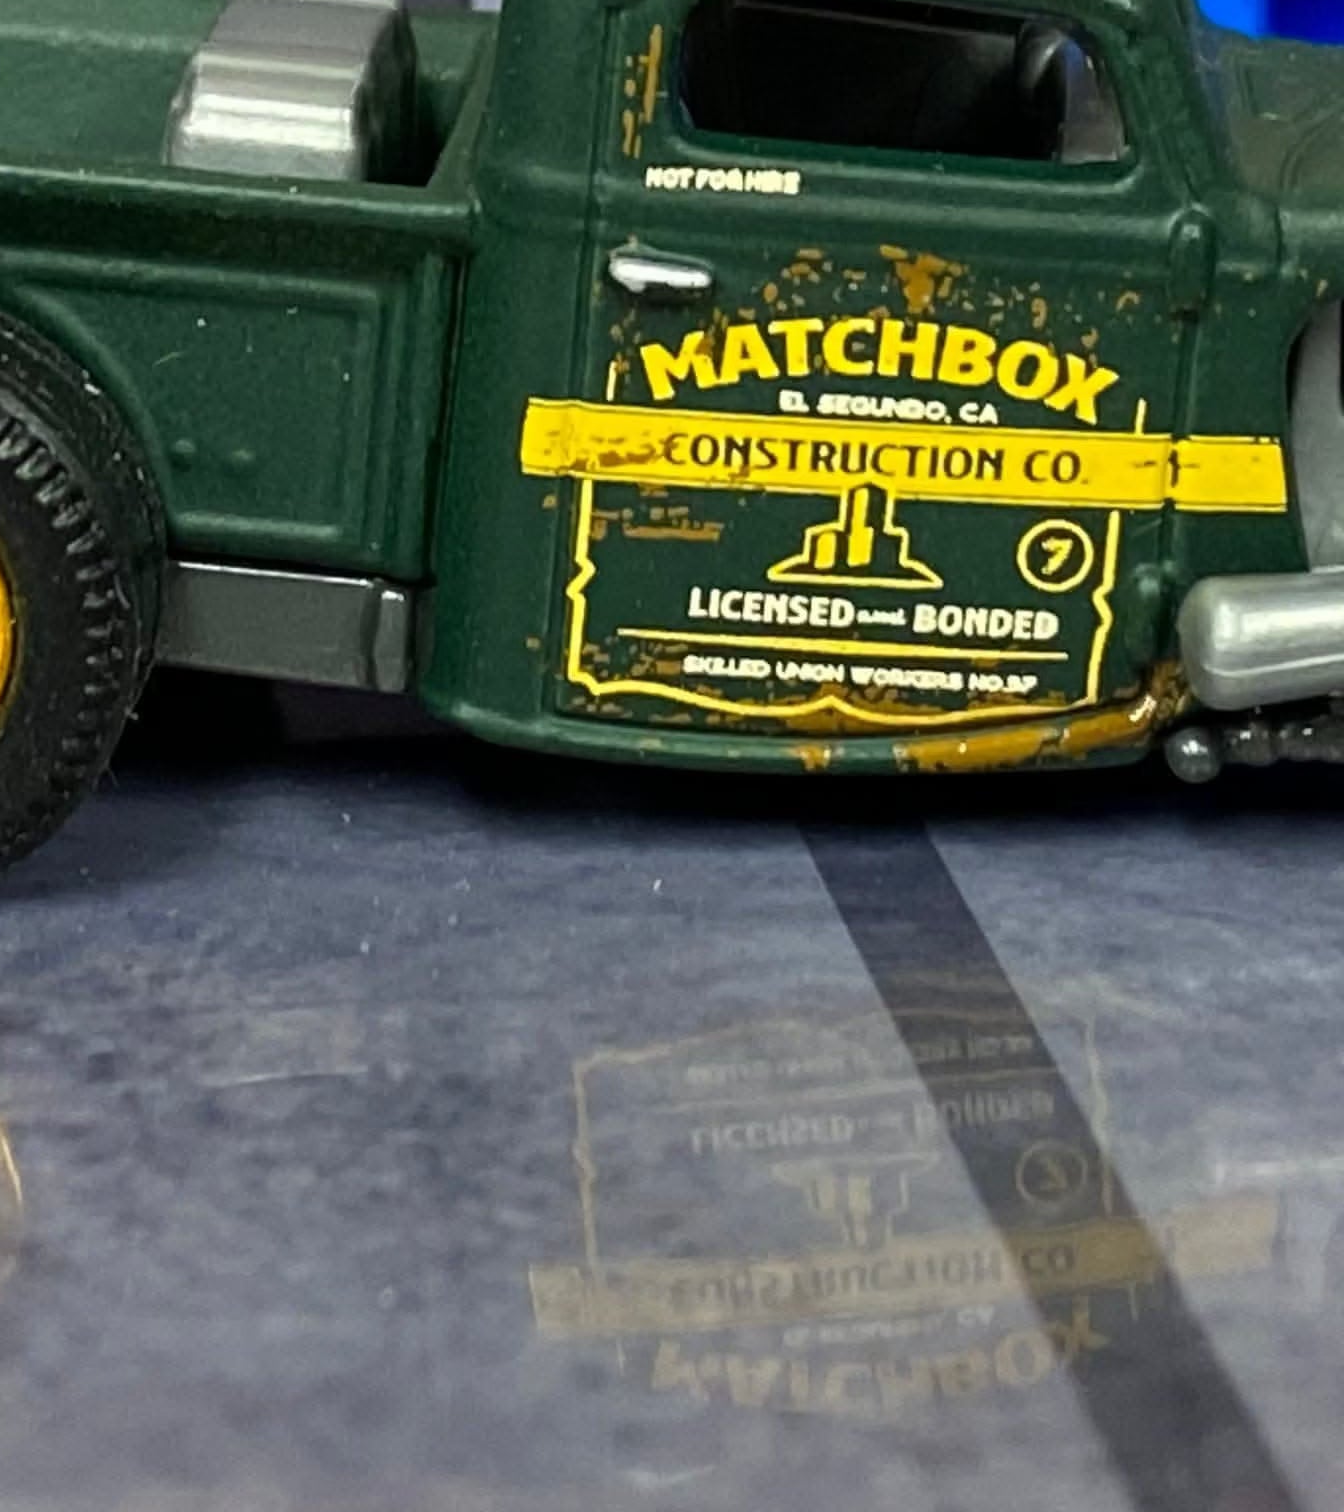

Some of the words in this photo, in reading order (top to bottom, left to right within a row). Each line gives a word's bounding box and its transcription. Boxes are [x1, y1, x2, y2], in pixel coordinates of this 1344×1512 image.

[645, 167, 694, 189] NOT
[640, 317, 1119, 425] MATCHBOX
[778, 389, 809, 413] EL
[959, 402, 999, 425] CA
[663, 433, 1004, 482] CONSTRUCTION
[688, 586, 856, 628] LICENSED
[913, 603, 1059, 641] BONDED
[775, 660, 844, 683] UNION
[850, 666, 964, 692] WORKERS
